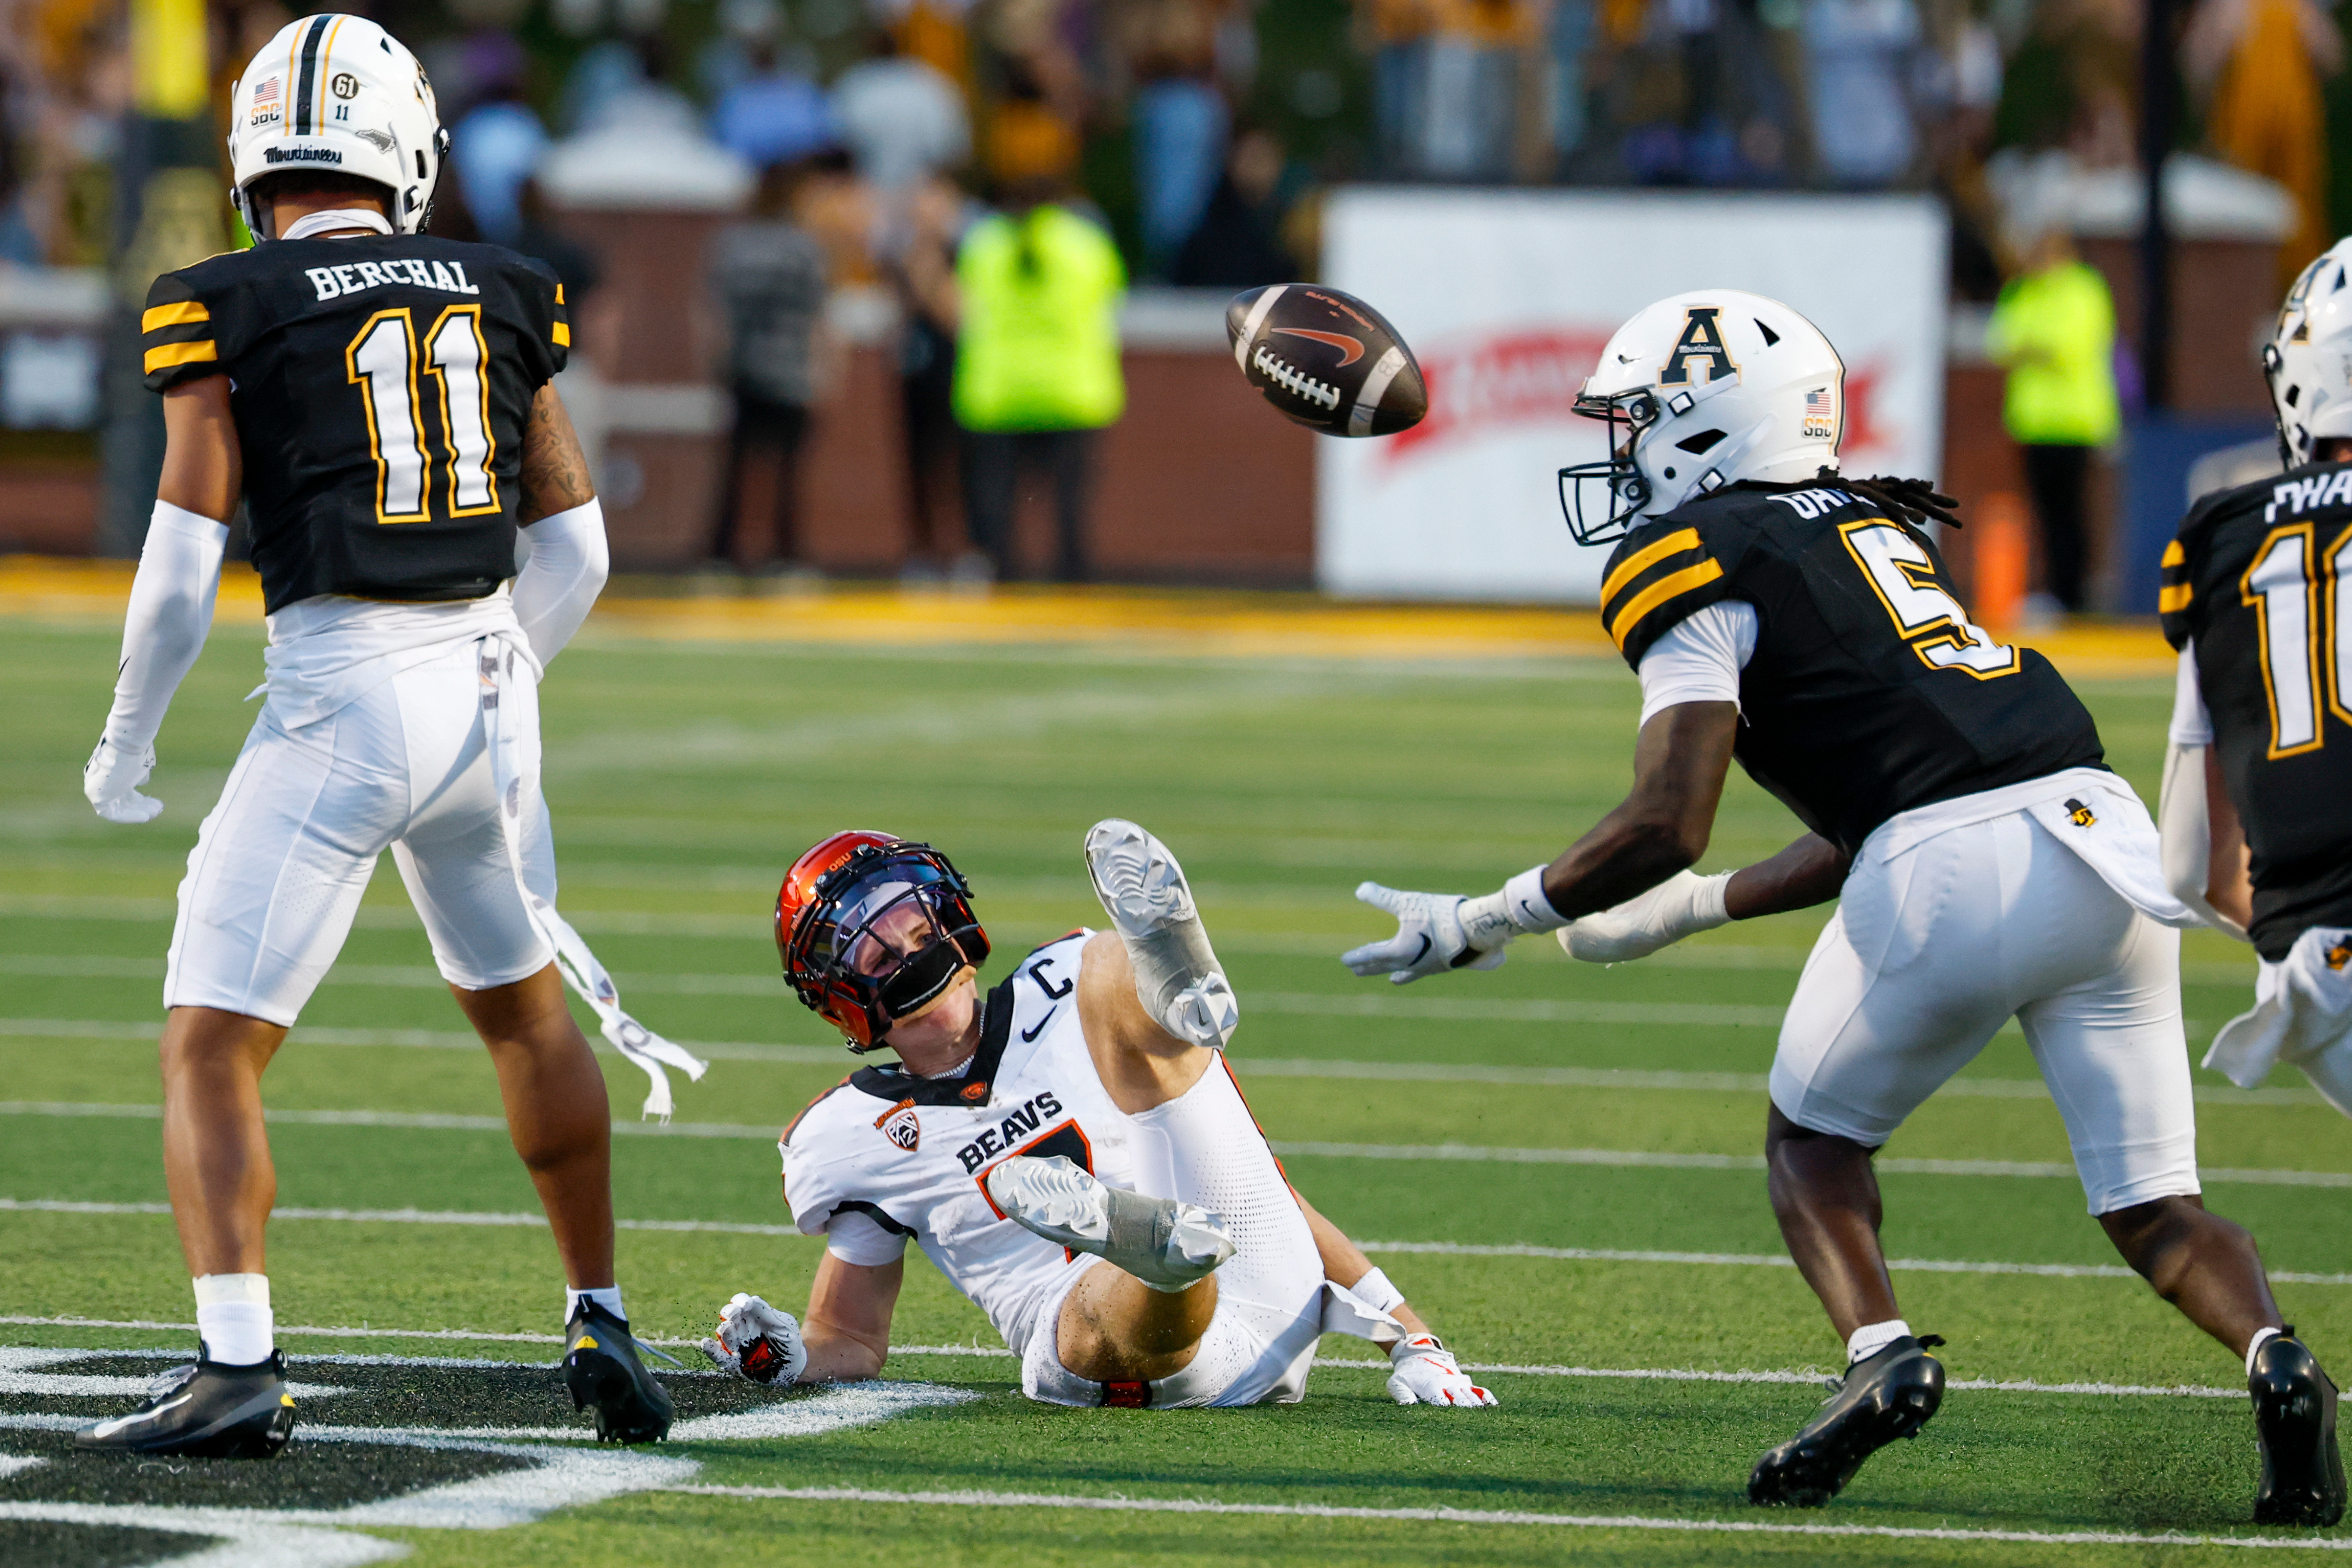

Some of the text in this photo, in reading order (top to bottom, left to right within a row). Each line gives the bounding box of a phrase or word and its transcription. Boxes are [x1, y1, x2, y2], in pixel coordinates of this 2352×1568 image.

[335, 75, 356, 98] 61
[251, 102, 280, 126] SBC
[335, 104, 349, 121] 11
[263, 143, 343, 164] Mountaineers
[305, 259, 480, 302] BERCHAL
[1658, 306, 1741, 389] A
[345, 303, 503, 524] 11
[1804, 418, 1832, 437] SBC
[1836, 517, 2021, 681] 5
[1029, 958, 1073, 1000] C
[886, 1112, 918, 1145] PAC
[899, 1128, 917, 1148] 12
[955, 1091, 1063, 1176] BEAVS
